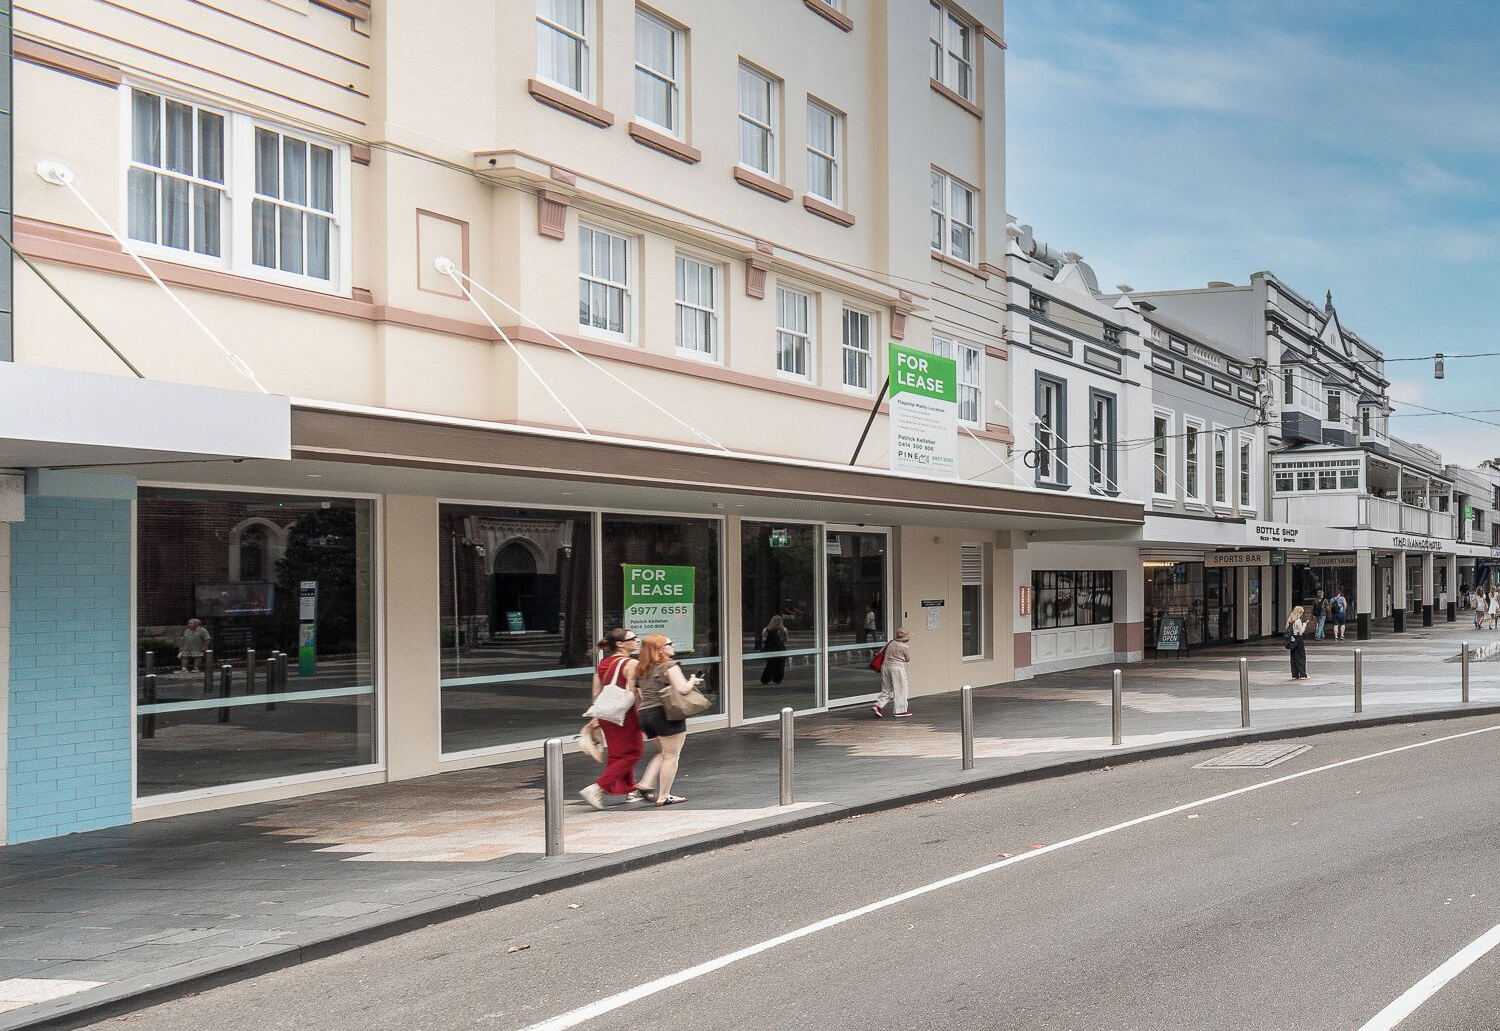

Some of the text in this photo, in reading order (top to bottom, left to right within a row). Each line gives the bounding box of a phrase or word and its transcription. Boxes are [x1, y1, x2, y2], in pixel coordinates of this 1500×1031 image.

[897, 352, 928, 373] FOR
[897, 370, 944, 394] LEASE
[898, 434, 915, 442] Patrick
[898, 450, 919, 460] PINE
[1256, 526, 1299, 537] BOTTLE SHOP
[1213, 555, 1244, 563] SPORTS
[1245, 554, 1262, 563] BAR
[631, 569, 666, 581] FOR
[631, 584, 683, 596] LEASE
[630, 606, 688, 615] 9977 6555
